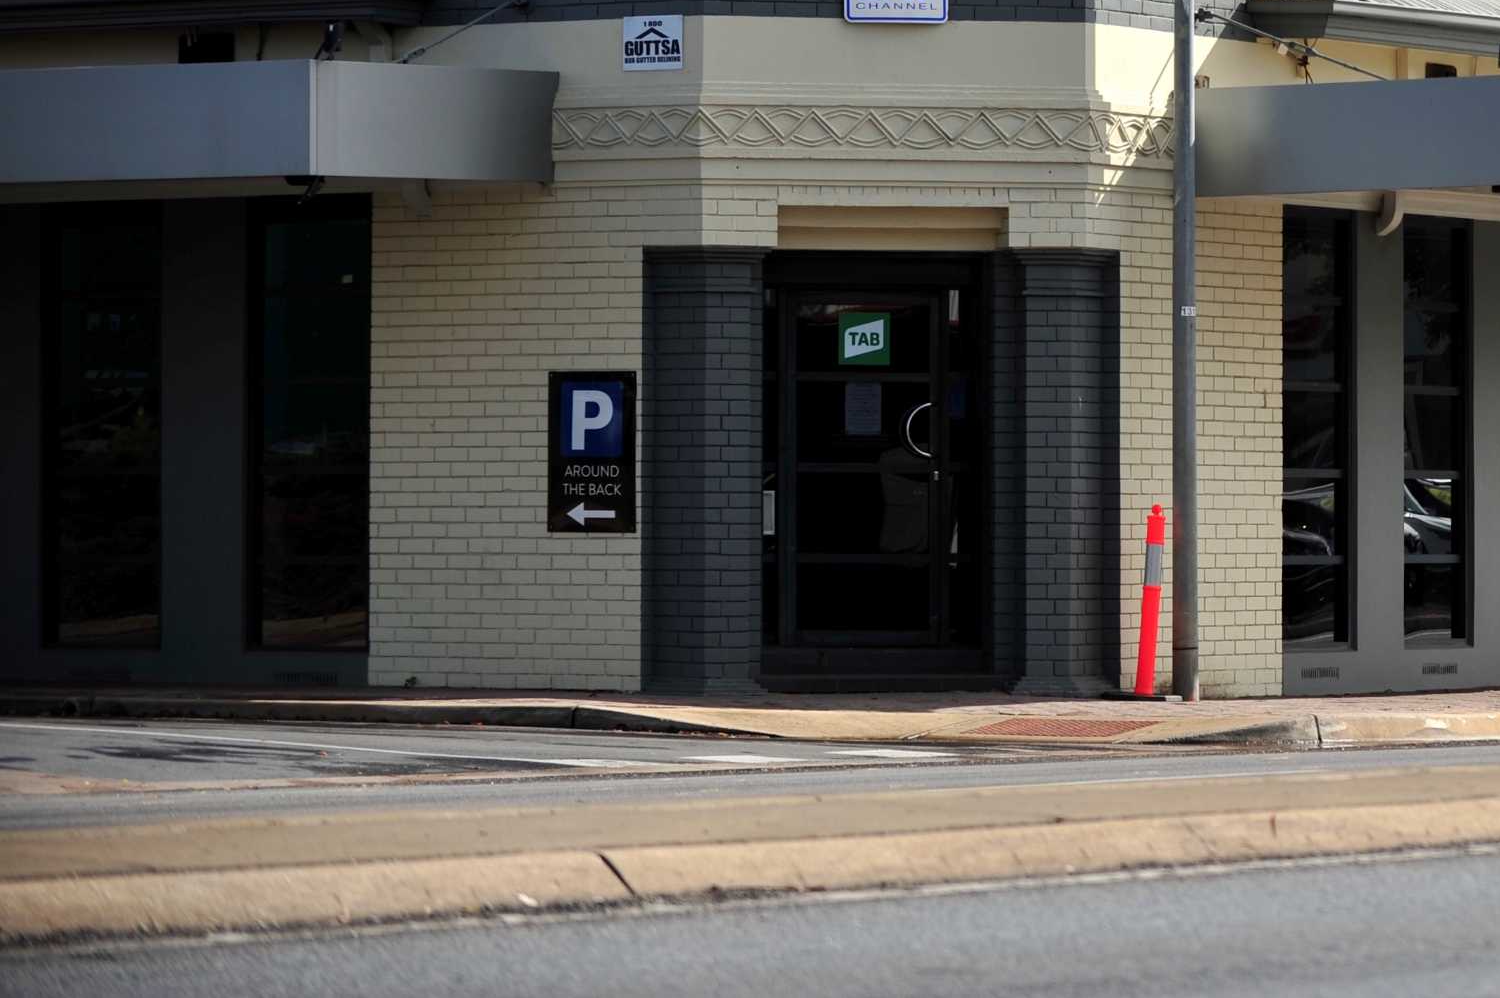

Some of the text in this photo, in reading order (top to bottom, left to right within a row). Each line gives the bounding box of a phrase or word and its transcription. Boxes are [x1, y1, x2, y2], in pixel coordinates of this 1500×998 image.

[855, 2, 937, 11] CHANNEL
[624, 39, 680, 56] GUTTSA
[848, 332, 880, 346] TAB
[571, 390, 614, 450] P
[564, 465, 620, 478] AROUND
[562, 483, 622, 496] THE BACK
